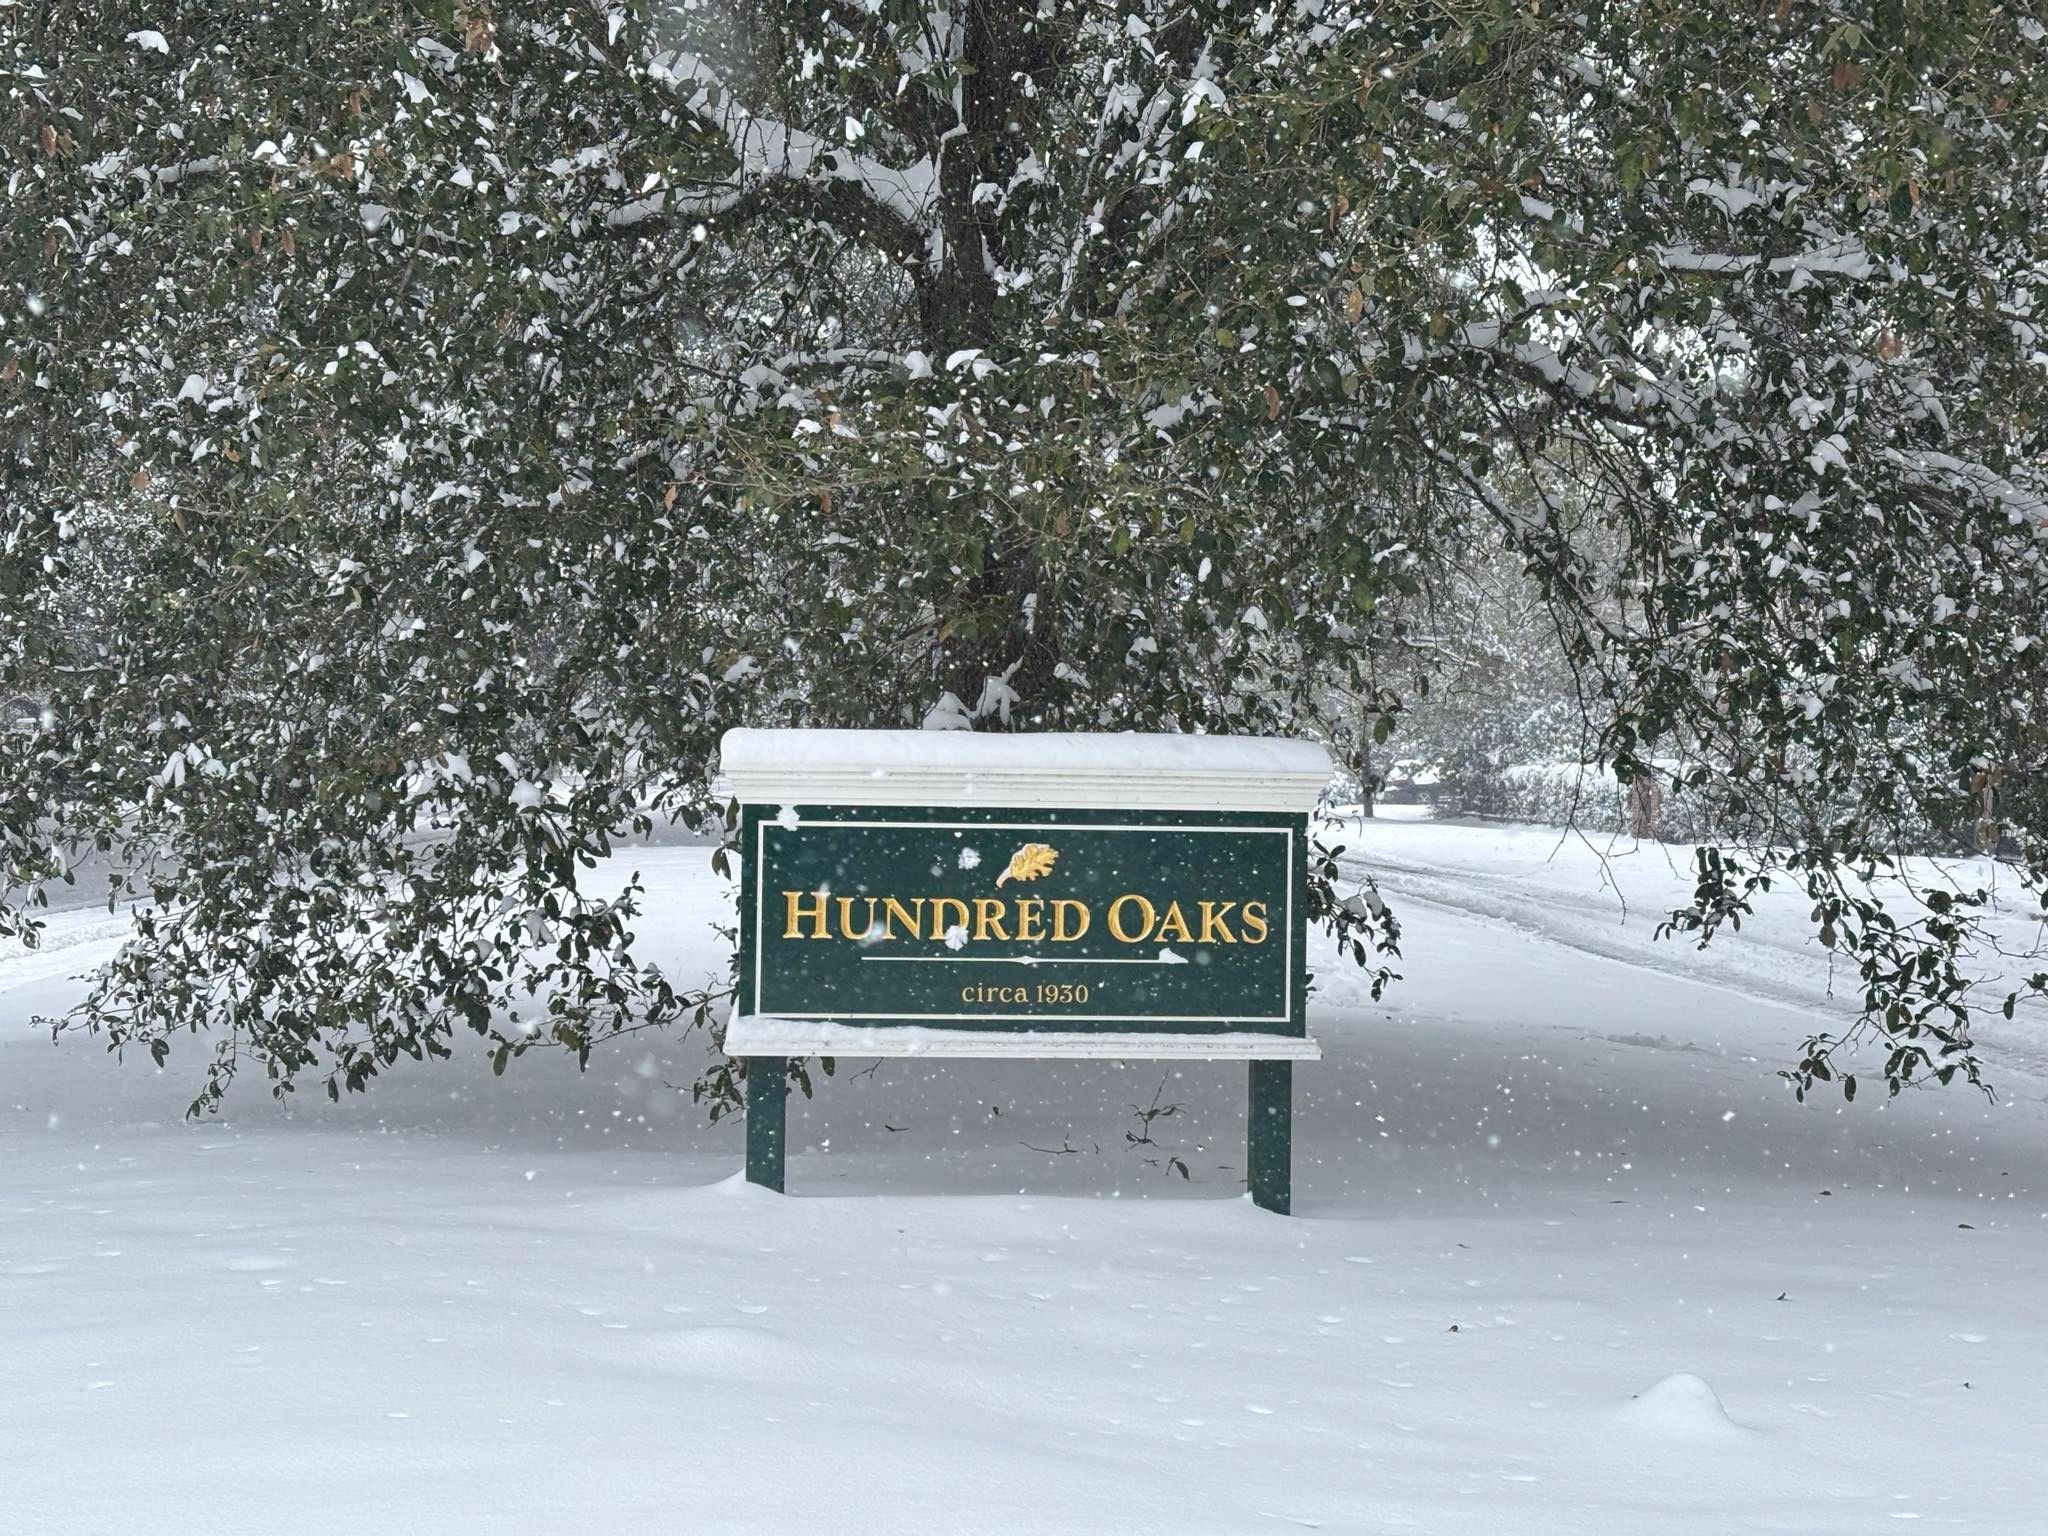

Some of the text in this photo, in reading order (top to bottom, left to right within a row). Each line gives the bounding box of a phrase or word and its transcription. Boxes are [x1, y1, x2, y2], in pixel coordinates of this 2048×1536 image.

[782, 891, 1268, 943] HUNDRED OAKS
[962, 982, 1089, 1004] circa 1930
